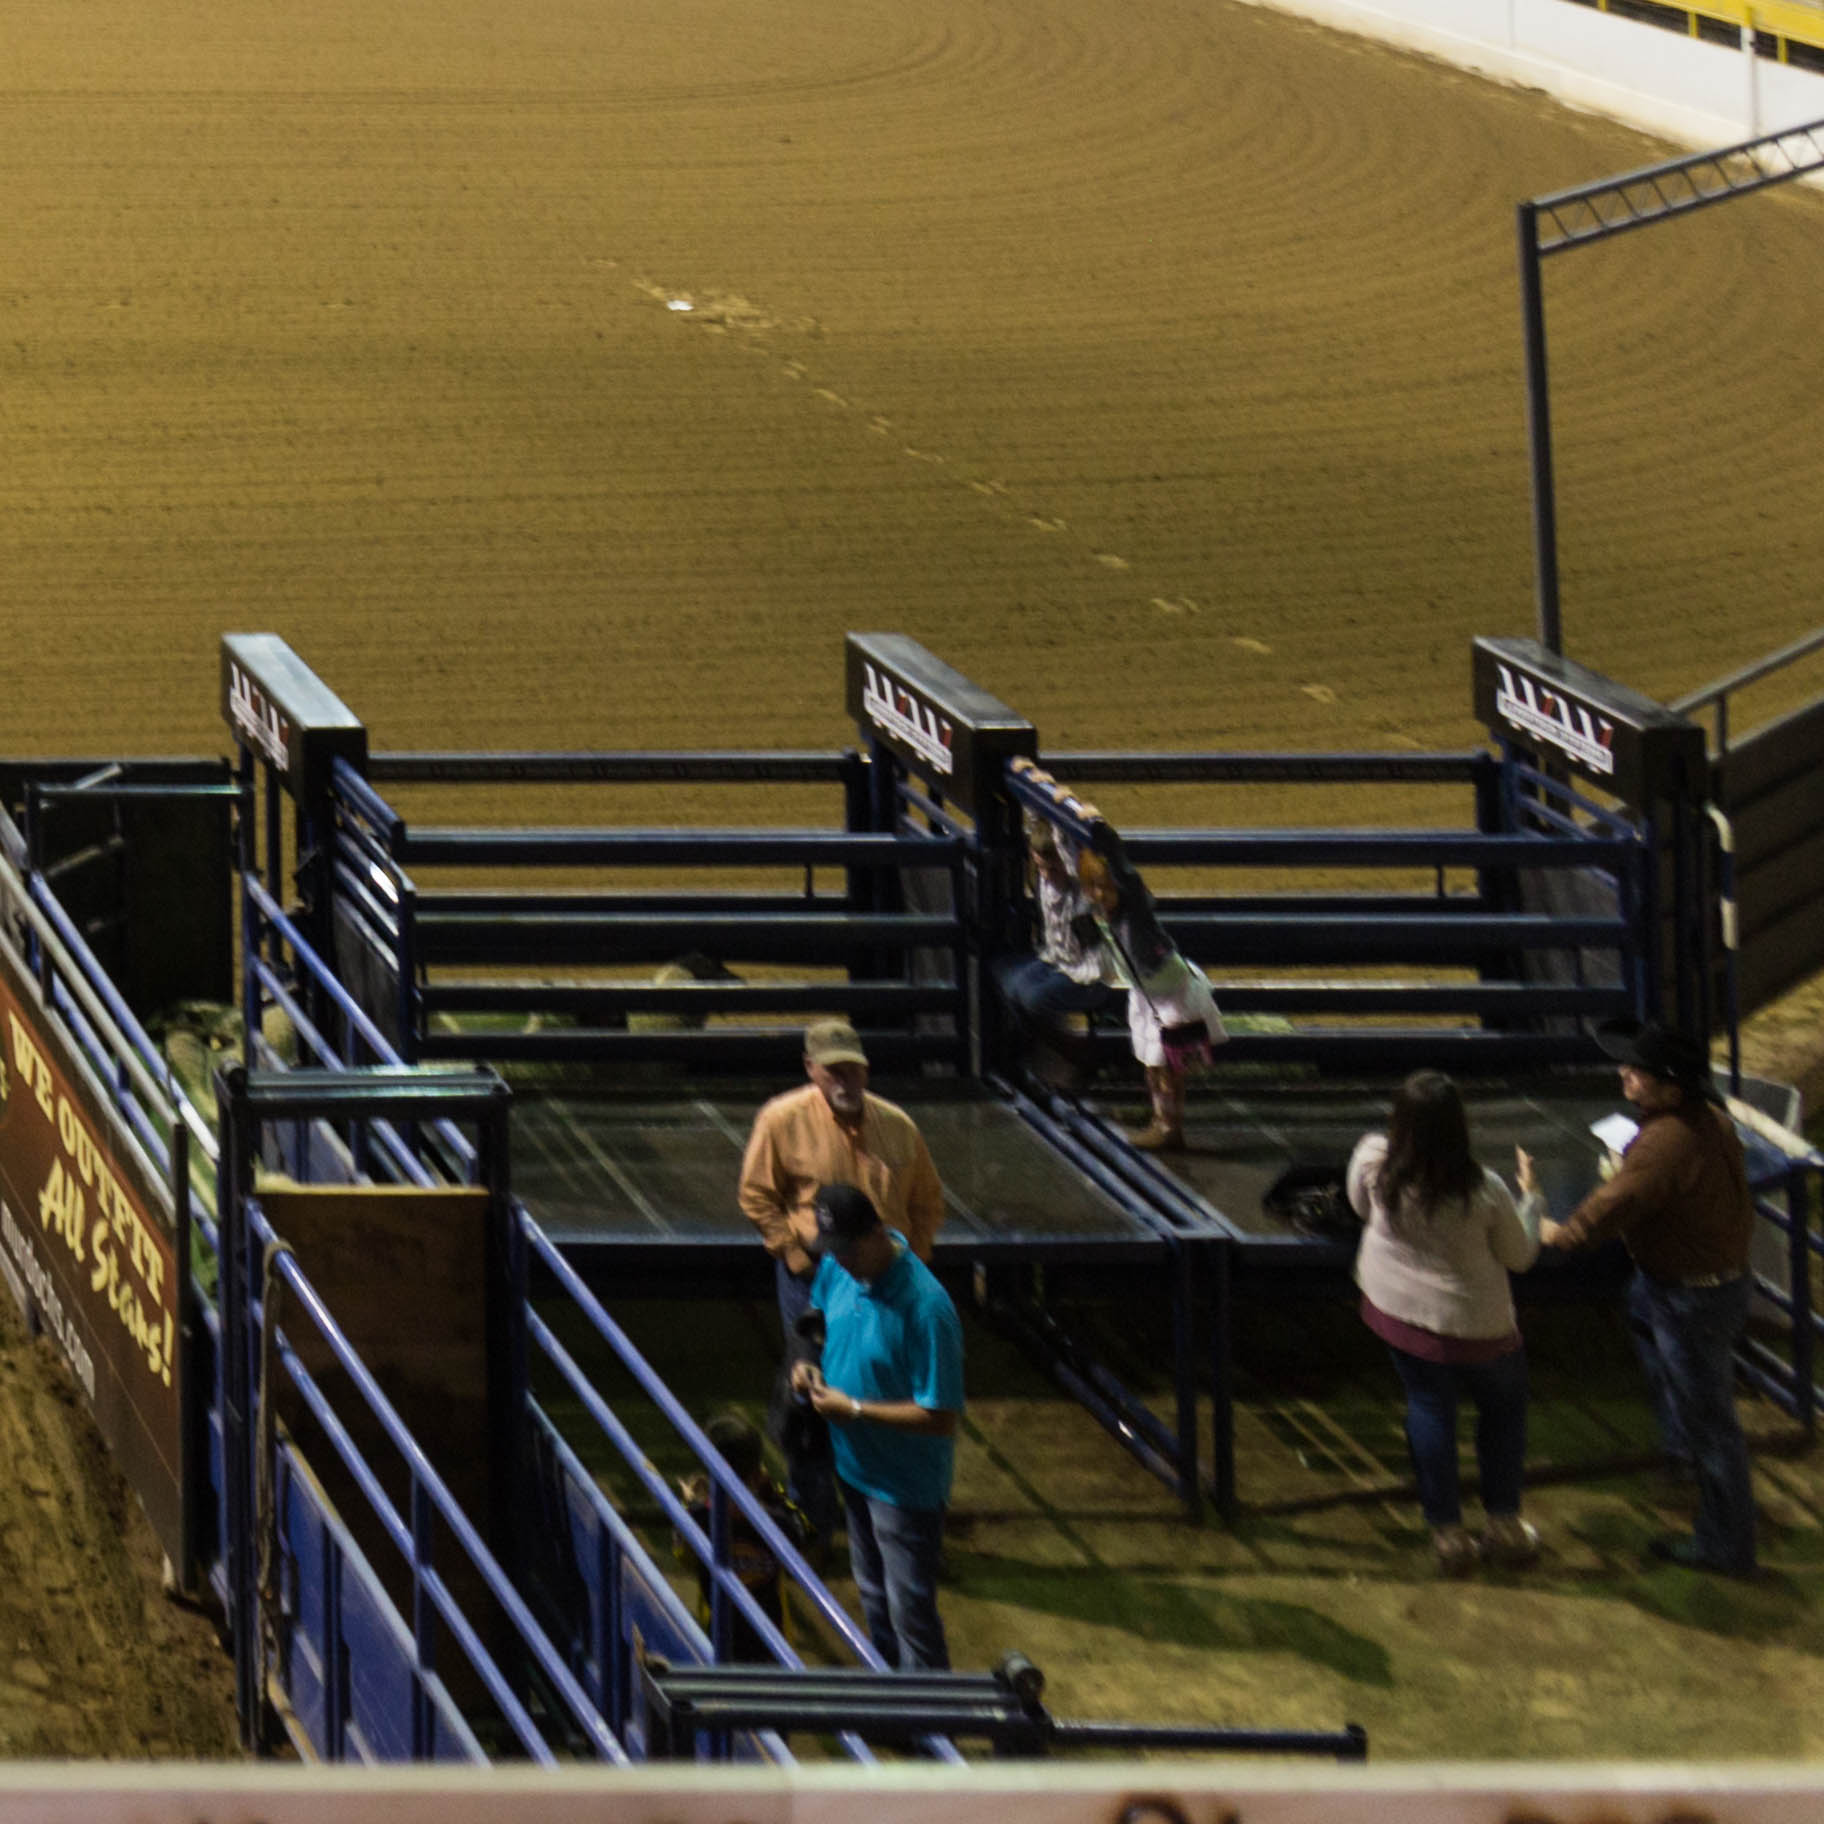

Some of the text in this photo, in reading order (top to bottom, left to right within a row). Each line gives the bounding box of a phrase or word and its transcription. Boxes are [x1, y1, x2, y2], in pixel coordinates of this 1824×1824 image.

[8, 1010, 166, 1307] WE OUTFIT
[0, 1198, 97, 1402] murdochs.com
